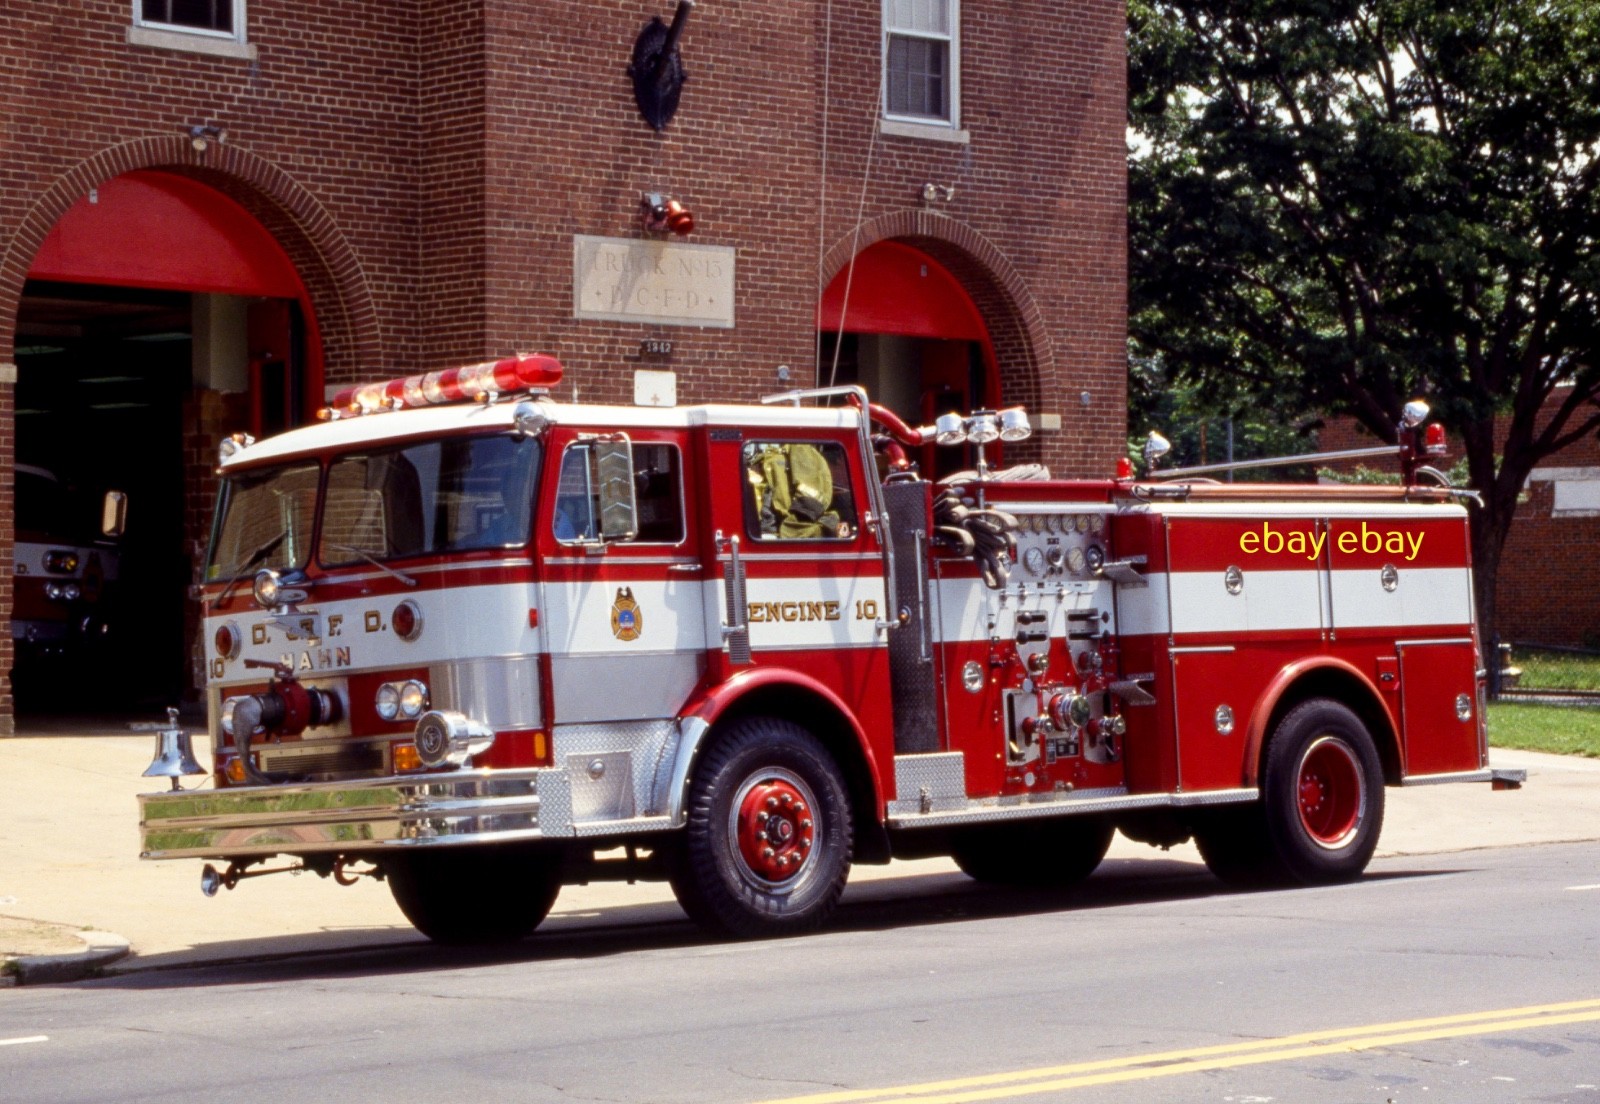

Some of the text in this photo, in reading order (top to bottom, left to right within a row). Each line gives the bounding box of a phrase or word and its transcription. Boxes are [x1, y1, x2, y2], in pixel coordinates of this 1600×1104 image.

[747, 599, 878, 623] ENGINE 10
[209, 658, 225, 679] 10
